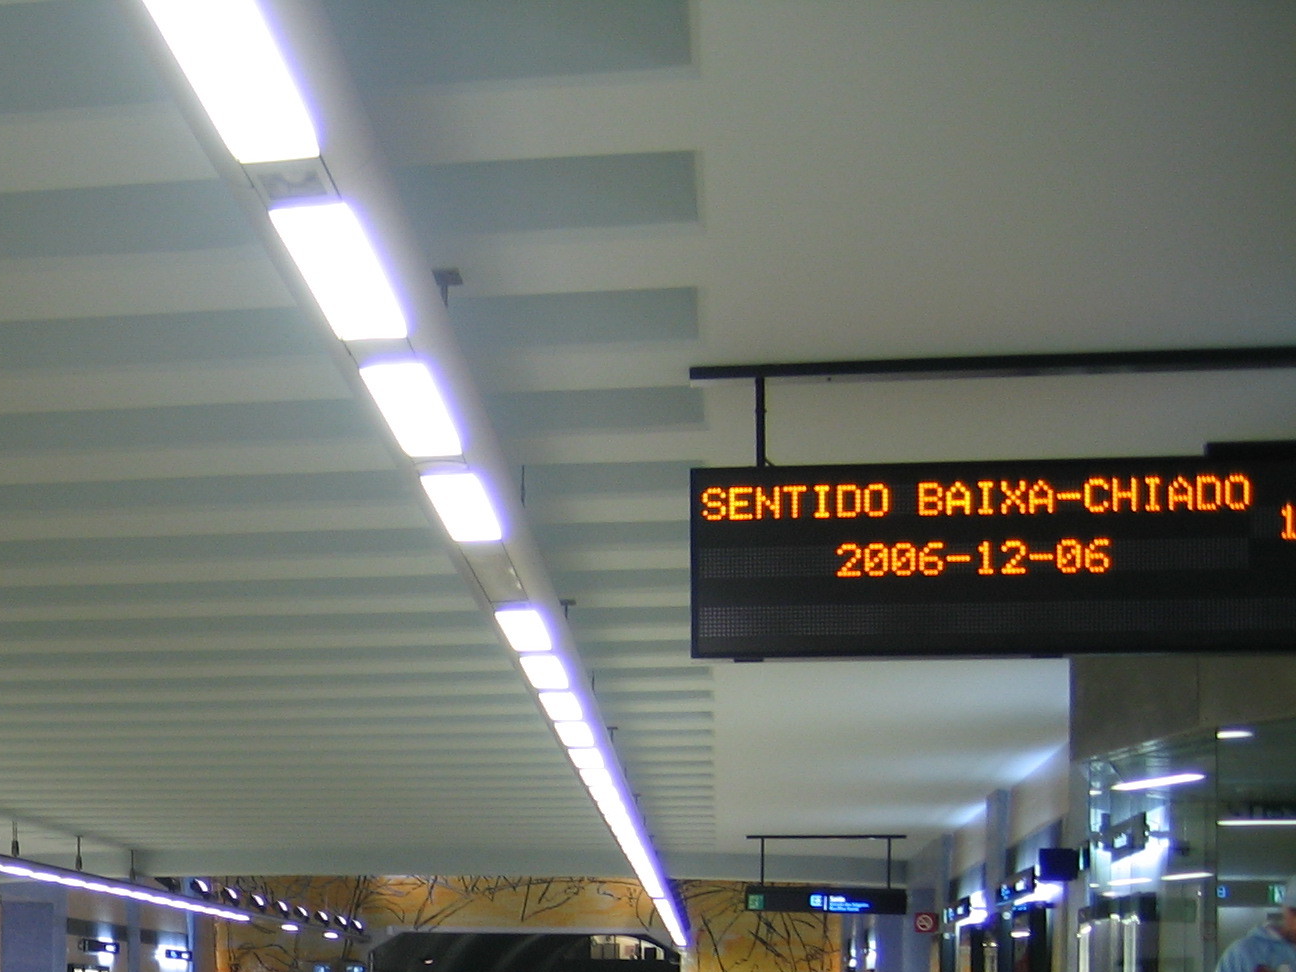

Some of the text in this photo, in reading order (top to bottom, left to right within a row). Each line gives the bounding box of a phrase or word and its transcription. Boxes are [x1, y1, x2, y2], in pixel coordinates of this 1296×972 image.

[702, 474, 1251, 521] SENTIDO BAIXA-CHIADO
[836, 539, 1111, 577] 2006-12-06
